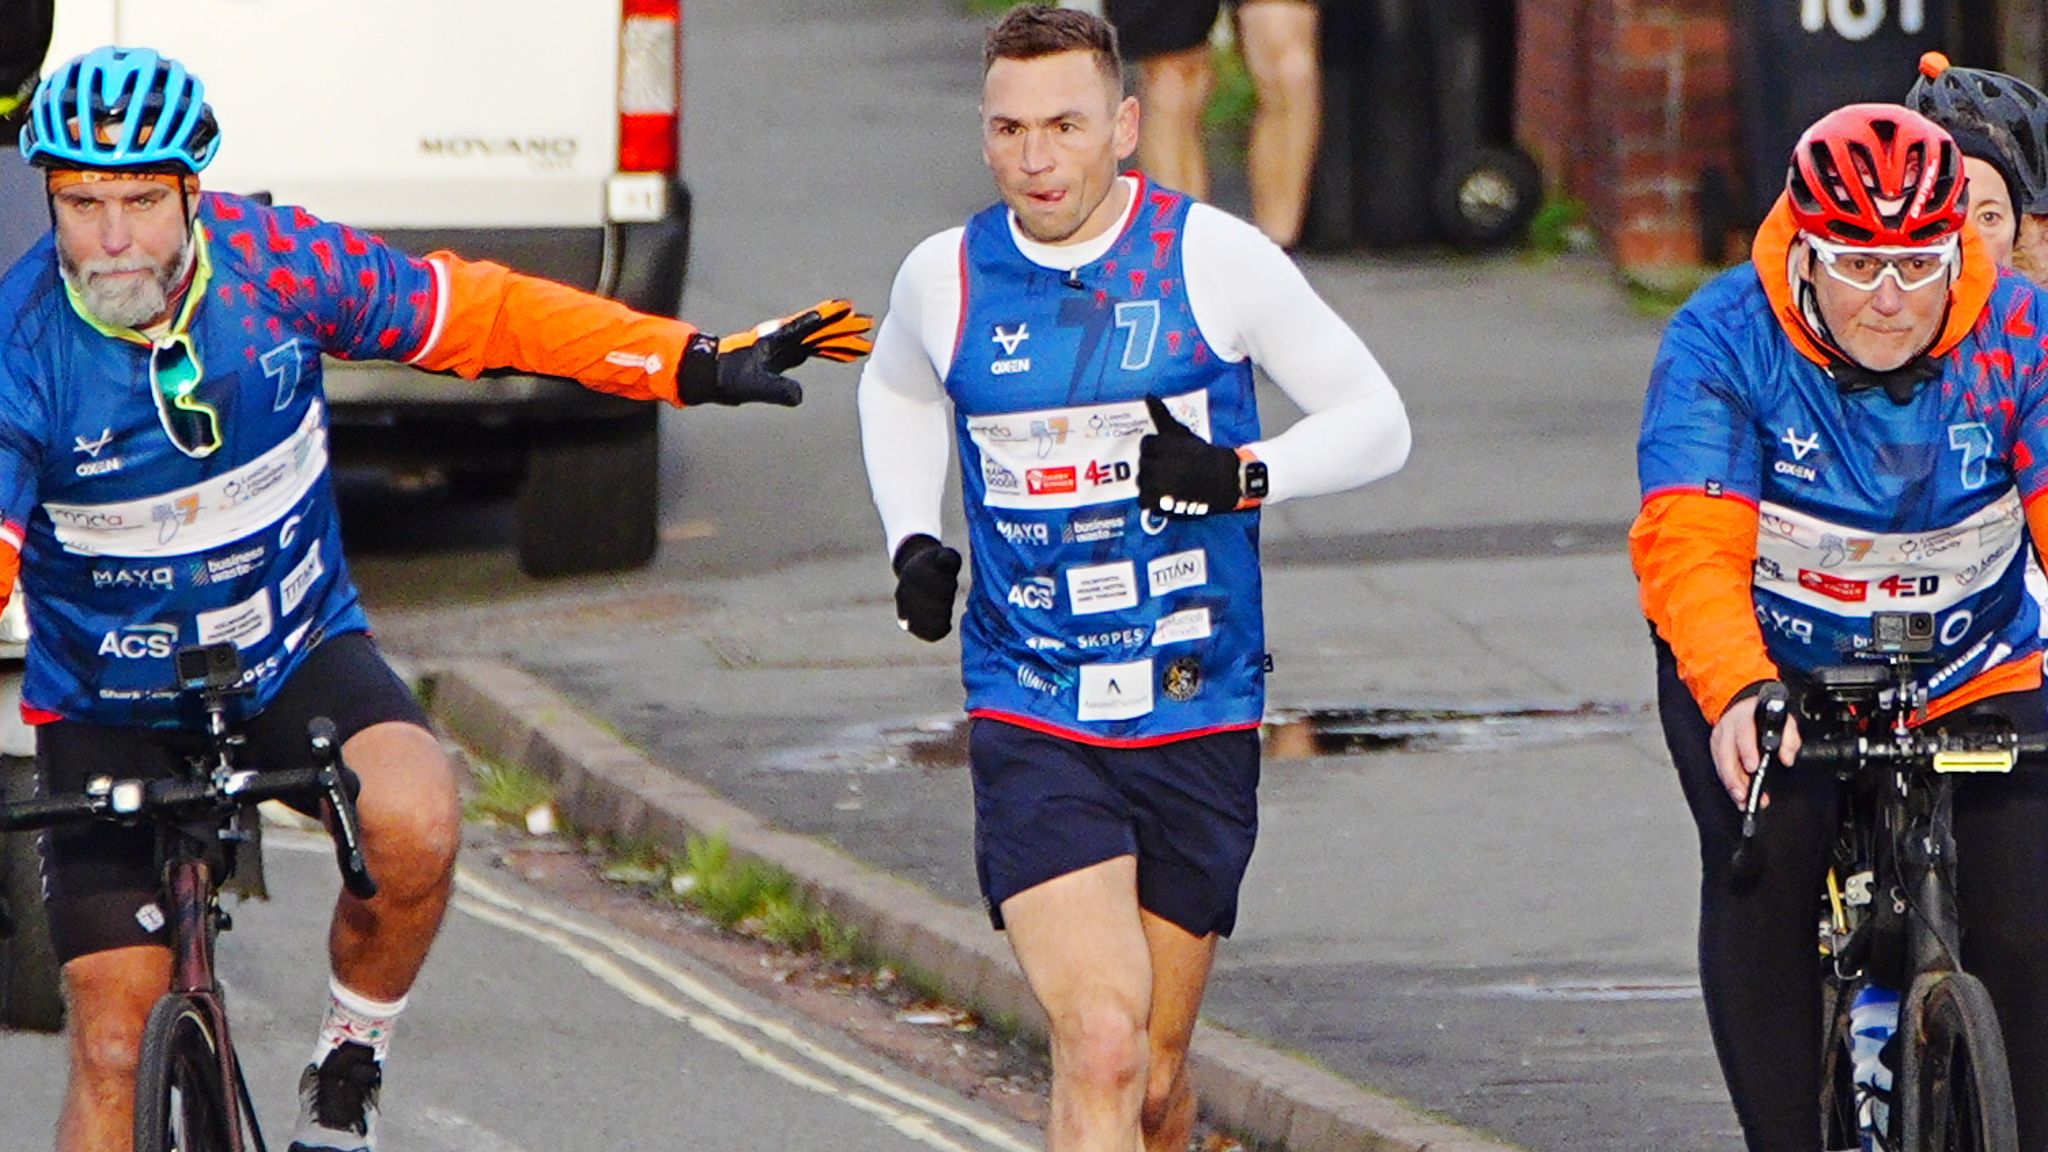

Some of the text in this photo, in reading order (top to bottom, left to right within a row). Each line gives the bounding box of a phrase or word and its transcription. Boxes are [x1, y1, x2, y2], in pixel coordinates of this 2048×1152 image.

[420, 137, 579, 157] MOVANO
[1114, 300, 1160, 371] 7
[990, 358, 1031, 375] OXEN
[1948, 422, 1992, 489] 7
[76, 459, 121, 477] OXEN
[1085, 460, 1131, 486] 4ED
[1774, 460, 1817, 482] OXEN
[997, 521, 1048, 540] MAYO
[92, 566, 174, 585] MAYO
[1878, 574, 1940, 598] 4ED
[1008, 585, 1053, 609] ACS
[97, 630, 172, 659] ACS
[1077, 628, 1145, 649] SKOPES
